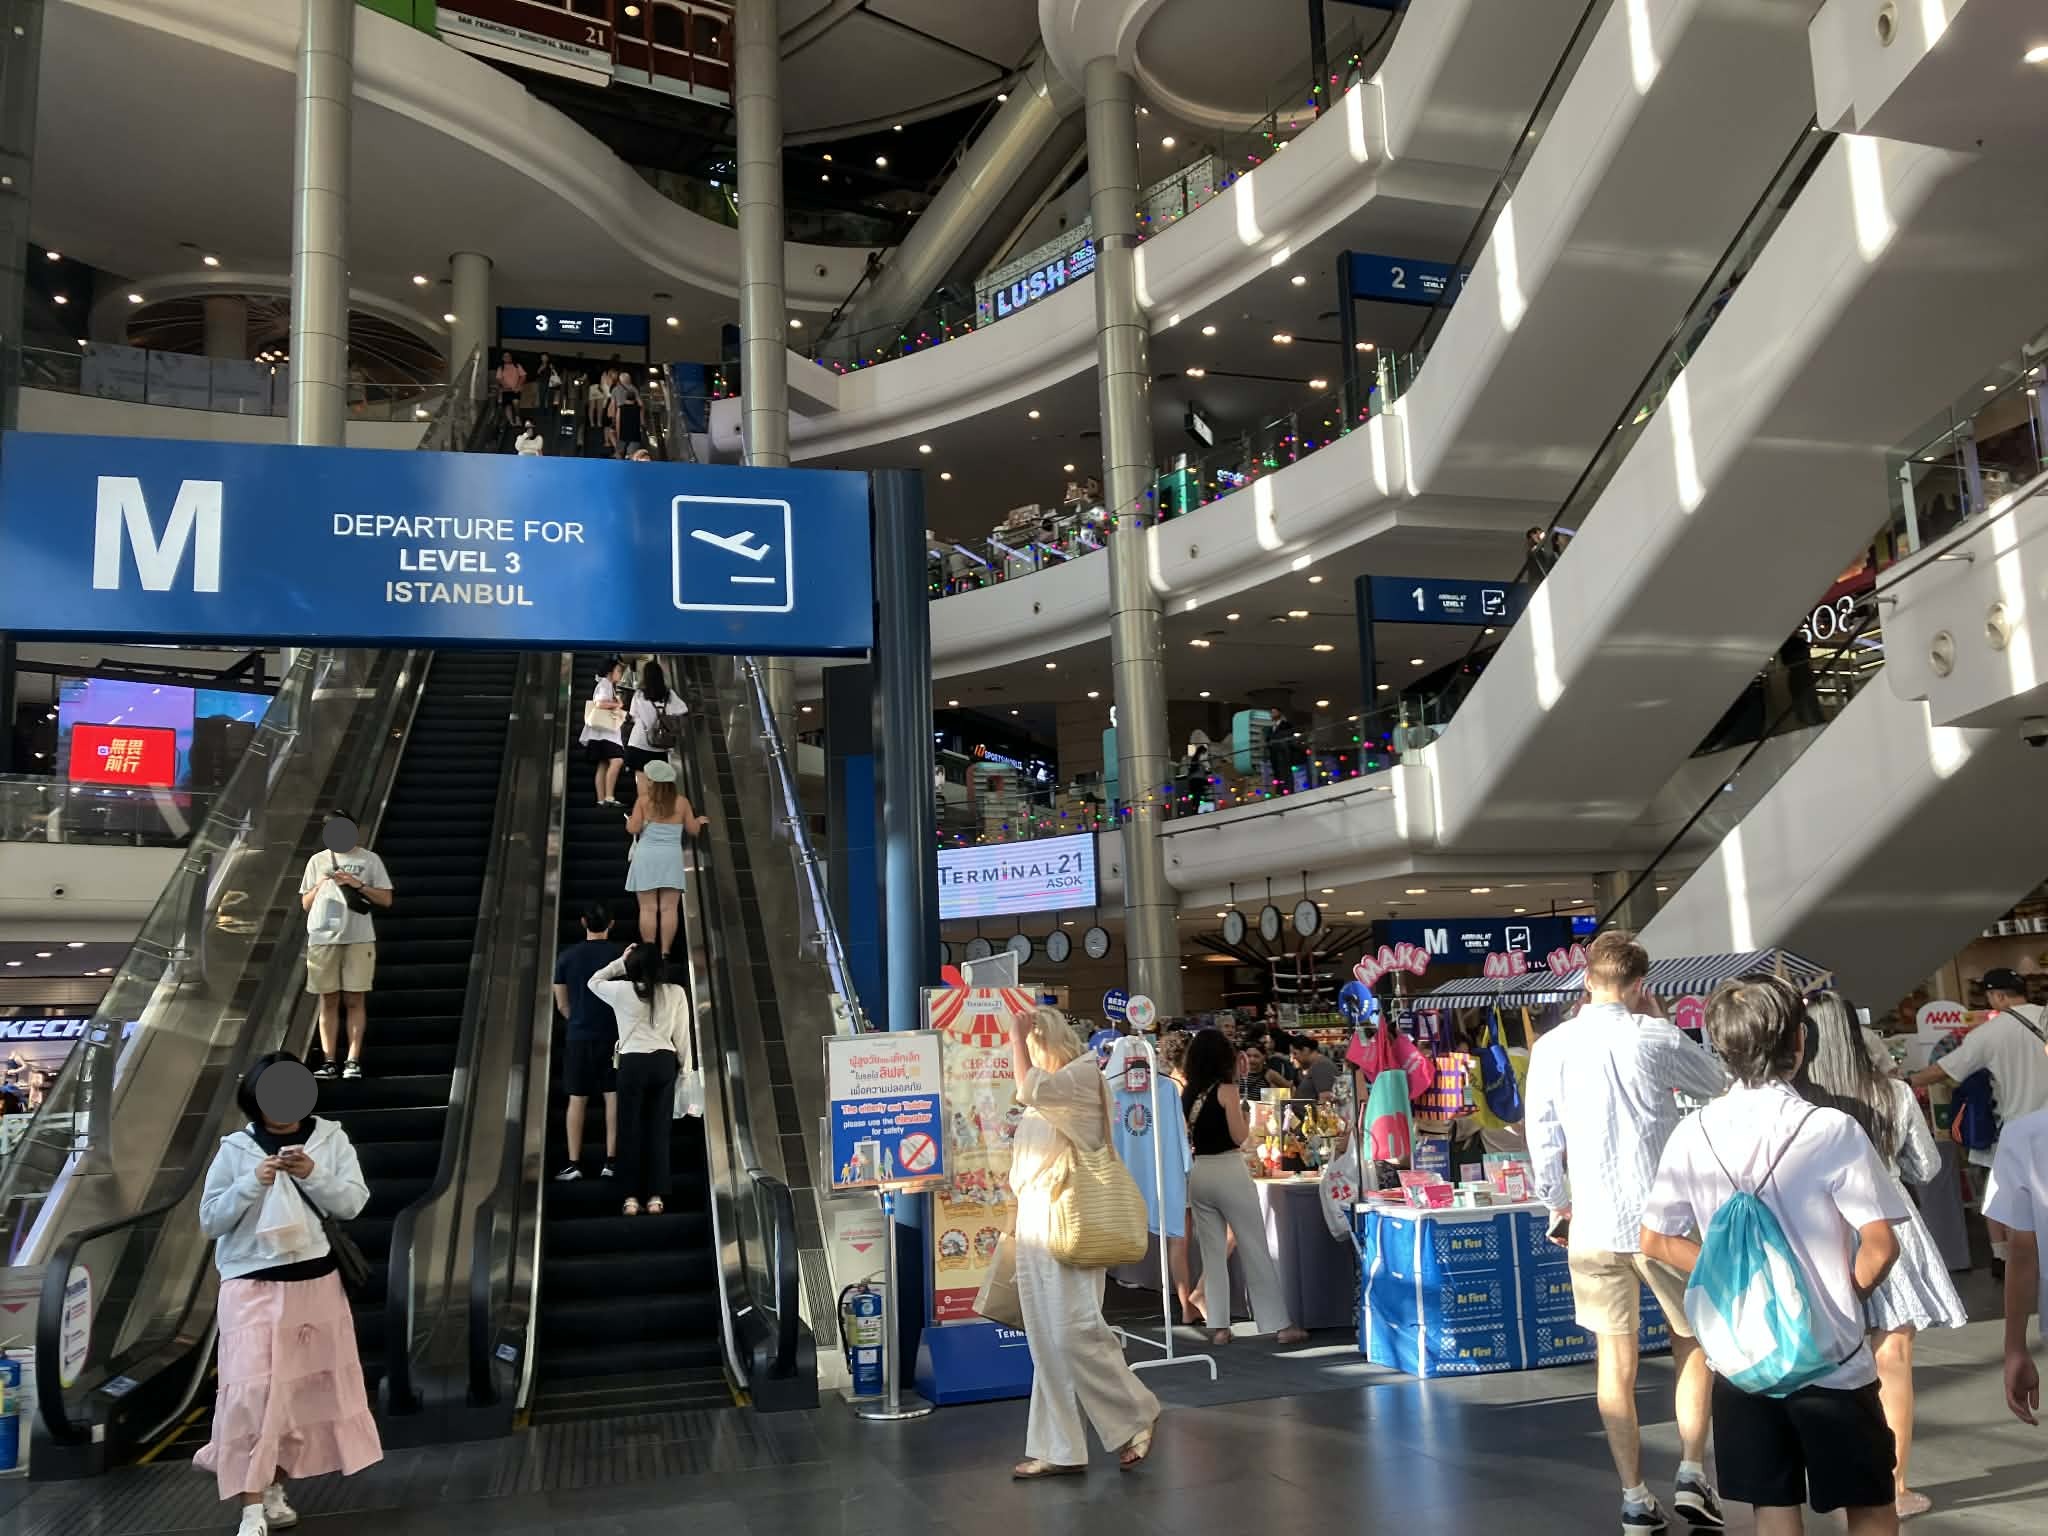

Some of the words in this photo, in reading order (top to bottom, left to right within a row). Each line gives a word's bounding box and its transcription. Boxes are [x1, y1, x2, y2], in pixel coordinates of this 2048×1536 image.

[585, 26, 604, 46] 21
[997, 259, 1065, 317] LUSH
[1391, 266, 1406, 289] 2
[535, 314, 548, 331] 3
[92, 475, 222, 593] M
[333, 513, 515, 542] DEPARTURE
[523, 520, 585, 543] FOR
[399, 548, 497, 573] LEVEL
[504, 551, 521, 574] 3
[385, 581, 534, 606] ISTANBUL
[1412, 587, 1425, 612] 1
[110, 738, 144, 756] 無畏
[104, 755, 141, 774] 前行
[1046, 875, 1083, 889] ASOK
[1424, 928, 1448, 955] M
[1353, 942, 1431, 988] MAKE
[1484, 951, 1528, 978] ME
[1547, 943, 1592, 977] HA
[0, 1020, 140, 1040] KECH
[843, 1120, 866, 1130] please
[882, 1118, 894, 1126] the
[872, 1128, 882, 1136] for
[883, 1126, 904, 1135] safety
[995, 1328, 1025, 1339] TERM
